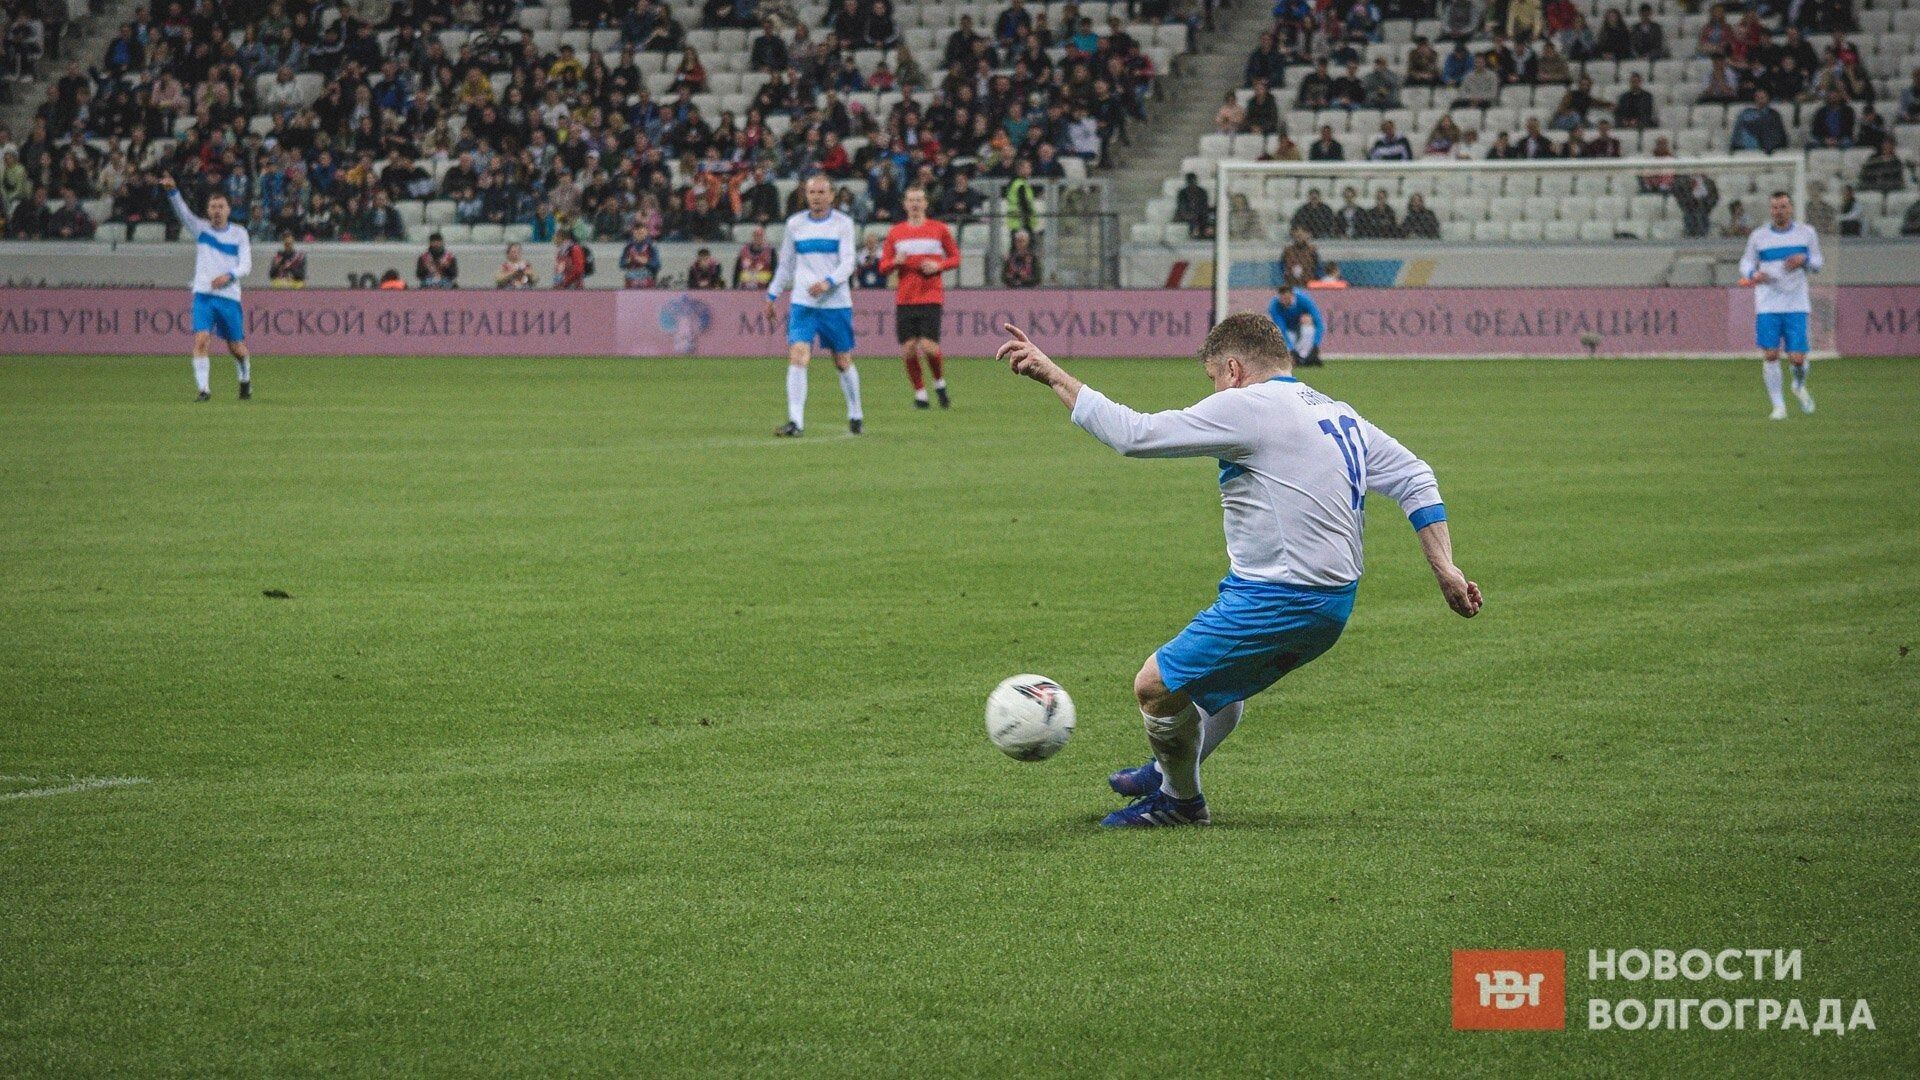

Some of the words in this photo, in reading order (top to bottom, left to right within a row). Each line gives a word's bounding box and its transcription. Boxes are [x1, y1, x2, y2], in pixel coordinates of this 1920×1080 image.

[0, 308, 119, 335] ЛЬТУРЫ
[134, 303, 364, 336] РОСЙСКОЙ
[377, 307, 572, 336] ФЕДЕРАЦИИ
[1028, 308, 1192, 337] КУЛЬТУРЫ
[1325, 303, 1453, 337] ЙСКОЙ
[1464, 307, 1680, 337] ФЕДЕРАЦИИ
[1318, 414, 1368, 511] 10
